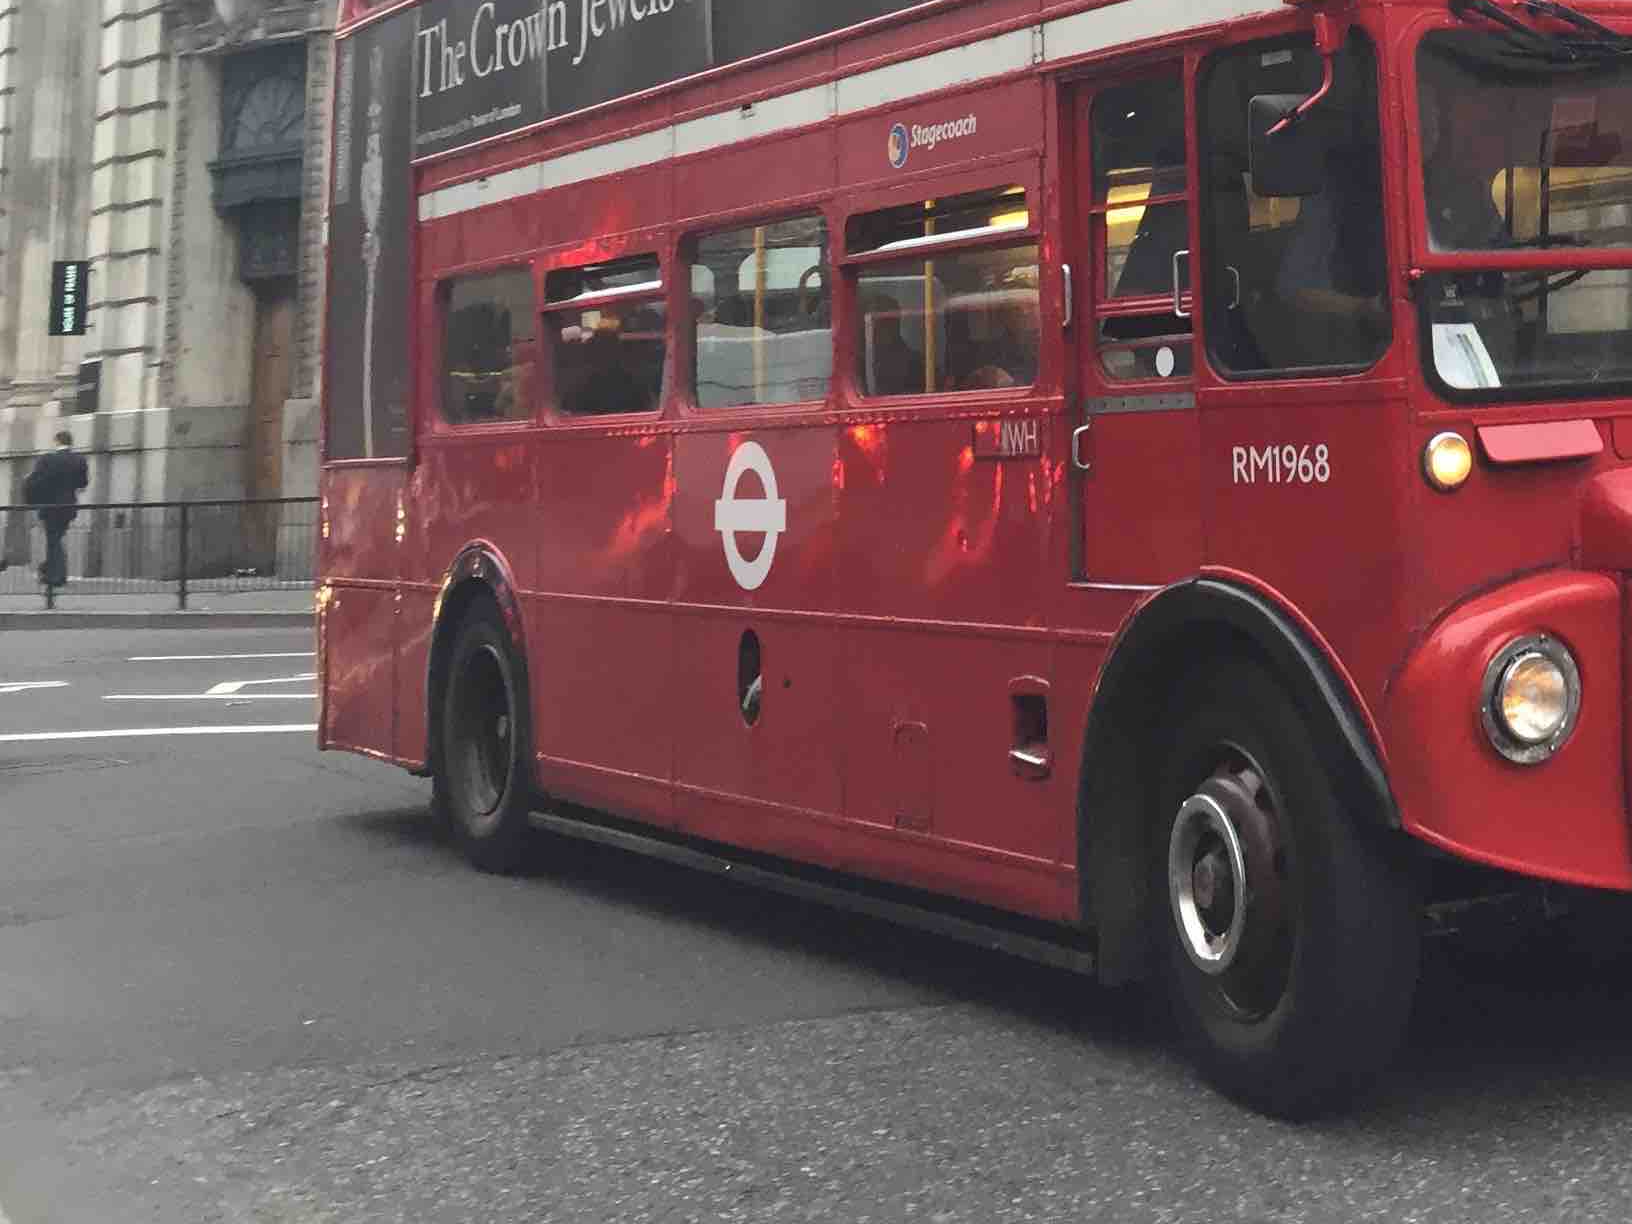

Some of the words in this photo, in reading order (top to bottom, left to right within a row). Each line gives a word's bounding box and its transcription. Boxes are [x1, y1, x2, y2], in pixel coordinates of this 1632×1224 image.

[416, 17, 467, 98] The
[469, 0, 569, 78] Crown
[910, 112, 977, 151] Stagecoach
[1231, 443, 1331, 484] RM1968
